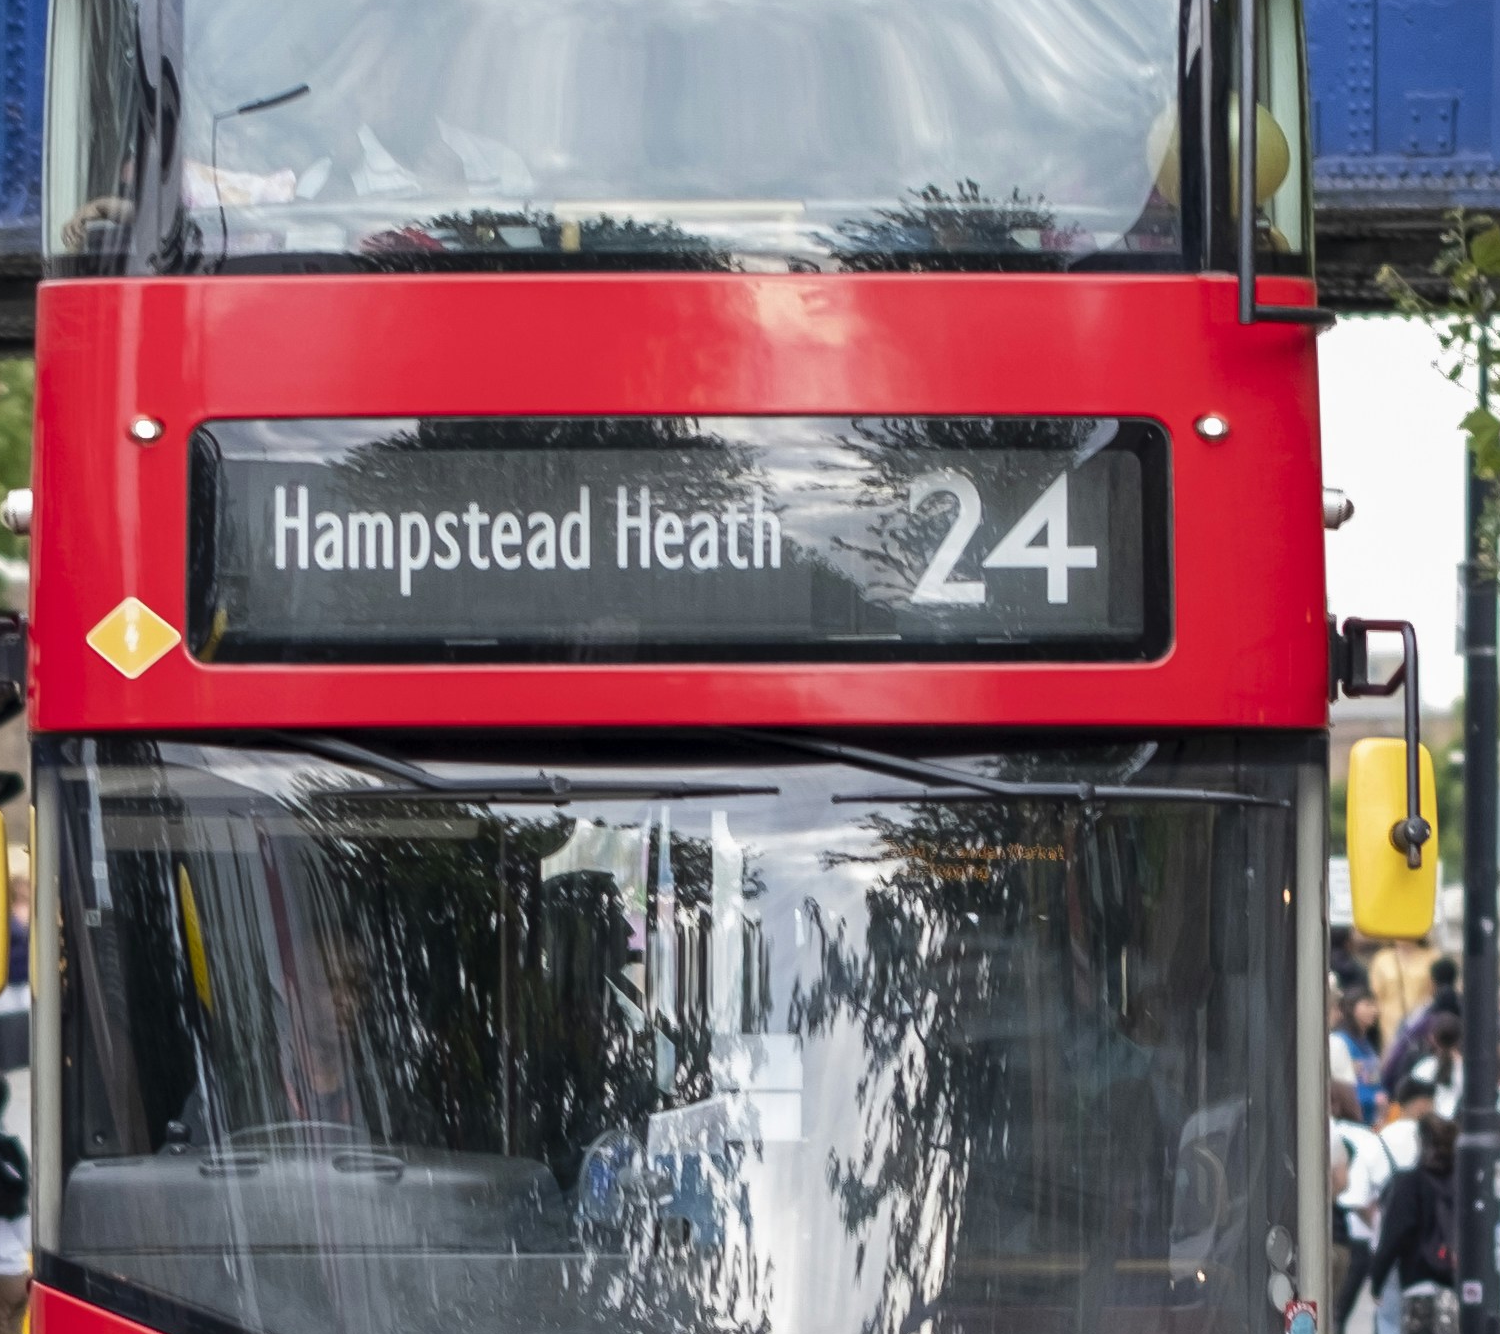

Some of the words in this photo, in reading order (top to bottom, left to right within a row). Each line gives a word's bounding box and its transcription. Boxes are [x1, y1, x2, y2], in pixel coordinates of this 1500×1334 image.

[273, 485, 592, 596] Hampstead
[616, 487, 783, 571] Heath
[908, 470, 1098, 604] 24
